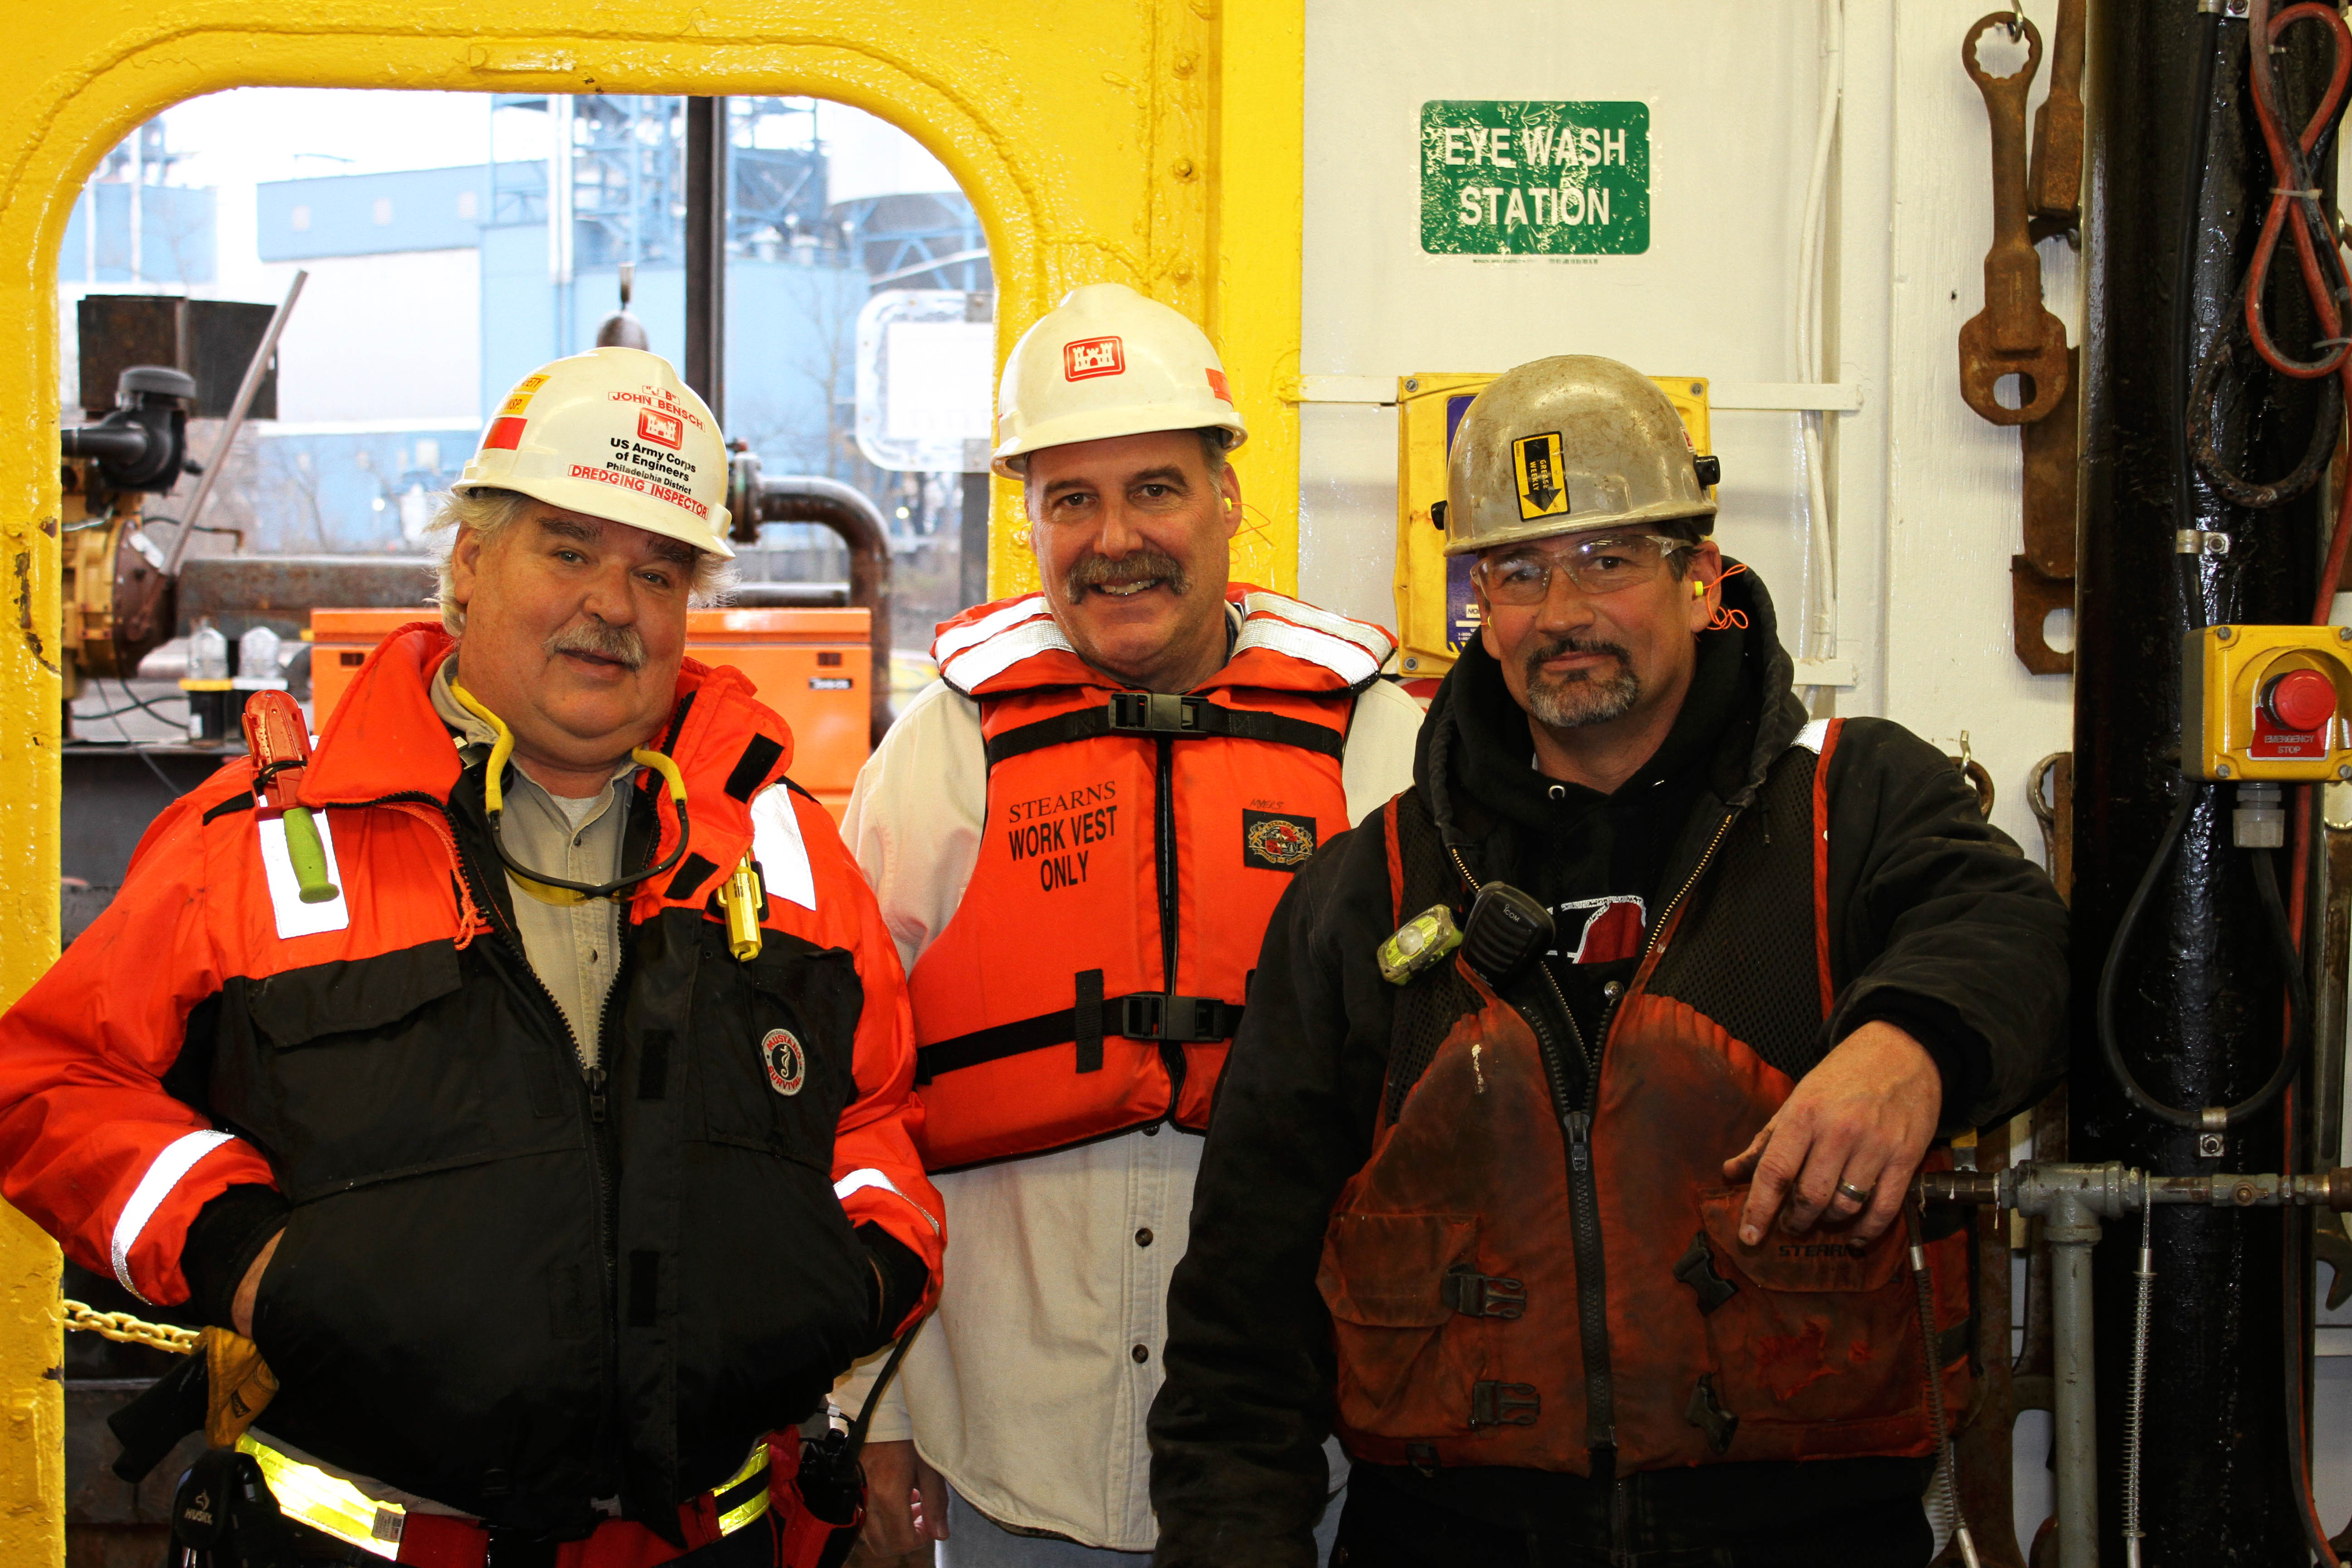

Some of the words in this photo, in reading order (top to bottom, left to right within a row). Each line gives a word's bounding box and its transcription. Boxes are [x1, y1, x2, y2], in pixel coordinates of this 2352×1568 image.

[1445, 127, 1511, 166] EYE
[1522, 127, 1626, 167] WASH
[1460, 186, 1610, 225] STATION
[612, 392, 652, 406] JOHN
[658, 400, 704, 430] BENSCH
[610, 437, 630, 449] US
[632, 443, 665, 461] Army
[666, 453, 696, 473] Corps
[615, 452, 629, 460] of
[632, 455, 690, 482] Engineers
[606, 461, 662, 483] Philadelphia
[664, 478, 692, 495] District
[1529, 461, 1540, 491] WEEKLY
[1539, 459, 1549, 489] GREASE
[572, 465, 645, 491] DREDGING
[651, 483, 708, 519] INSPECTOR
[2264, 735, 2314, 743] EMERGENCY
[2278, 745, 2301, 754] STOP
[1009, 780, 1116, 823] STEARNS
[1009, 819, 1066, 862] WORK
[1070, 805, 1117, 847] VEST
[1040, 850, 1089, 892] ONLY
[766, 1034, 802, 1060] MUSTANG
[768, 1065, 802, 1090] SURVIVAL
